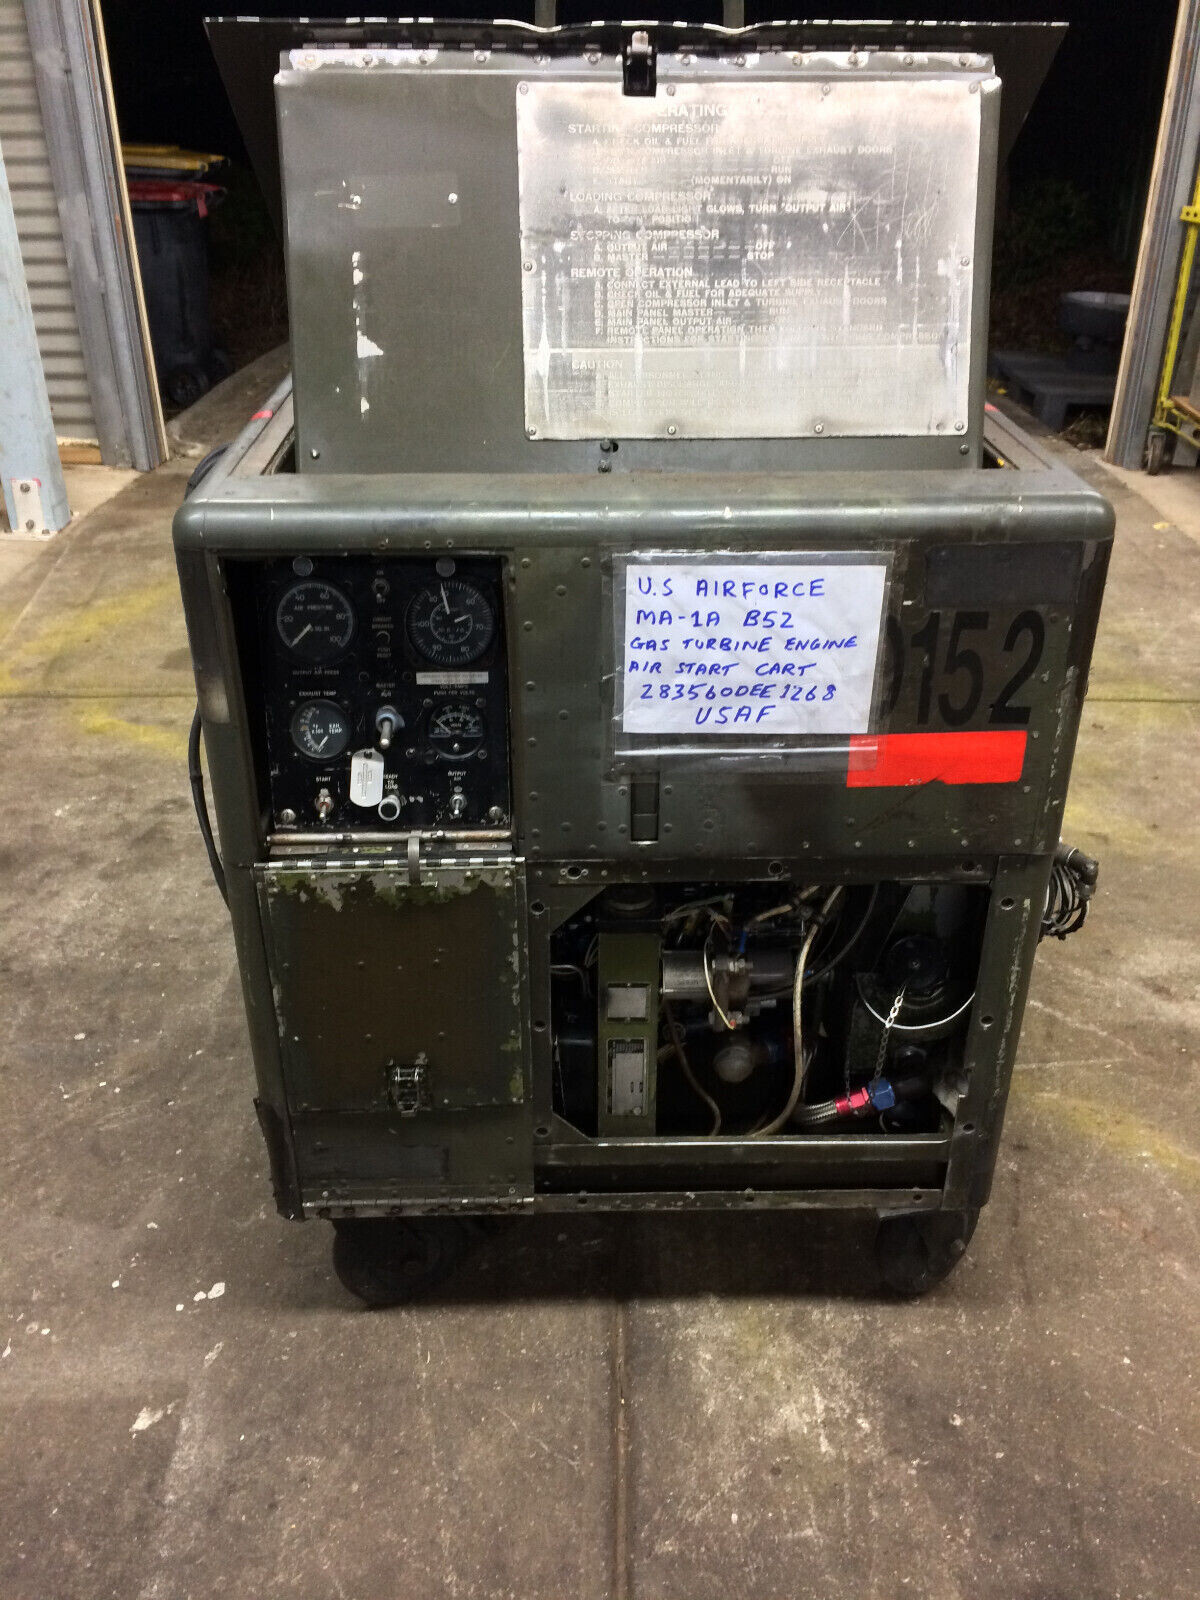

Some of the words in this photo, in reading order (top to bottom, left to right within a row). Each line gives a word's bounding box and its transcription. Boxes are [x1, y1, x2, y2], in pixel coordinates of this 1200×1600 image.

[568, 123, 625, 135] STARTIN
[770, 165, 792, 174] RUN
[691, 175, 772, 185] (MOMENTARILY)
[776, 175, 792, 185] ON
[569, 191, 623, 203] LOADING
[627, 190, 712, 202] COMPRESSOR
[748, 203, 778, 214] TURN
[636, 228, 721, 241] COMPRESSOR
[652, 241, 669, 252] AIR
[607, 252, 649, 262] MASTER
[746, 250, 776, 261] STOP
[571, 267, 622, 279] REMOTE
[625, 266, 694, 279] OPERATION
[607, 280, 656, 290] CONNECT
[659, 279, 711, 289] EXTERNAL
[714, 278, 741, 289] LEAD
[743, 278, 759, 288] TO
[761, 278, 786, 288] LEFT
[789, 278, 813, 288] SIDE
[644, 289, 662, 299] OIL
[677, 289, 701, 298] FUEL
[705, 288, 725, 298] FOR
[728, 288, 782, 298] ADEQUATE
[637, 299, 708, 309] COMPRESSOR
[711, 298, 741, 308] INLET
[607, 309, 634, 318] MAIN
[637, 309, 670, 318] PANEL
[672, 308, 714, 318] MASTER
[607, 318, 634, 328] MAIN
[637, 318, 670, 328] PANEL
[672, 317, 714, 327] OUTPUT
[716, 316, 733, 326] AIR
[652, 326, 685, 336] PANEL
[607, 335, 685, 345] INSTCTIONS
[571, 359, 624, 370] CAUTION
[637, 576, 674, 598] U.S
[696, 578, 826, 600] AIRFORCE
[635, 609, 722, 629] MA-1A
[742, 609, 796, 630] B52
[474, 622, 486, 632] 70
[629, 636, 672, 652] GAS
[682, 636, 774, 654] TURBINE
[783, 635, 859, 652] ENGINE
[628, 660, 663, 675] AIR
[674, 661, 741, 678] START
[754, 662, 818, 679] CART
[323, 689, 338, 697] TEMP
[694, 704, 778, 726] USAF
